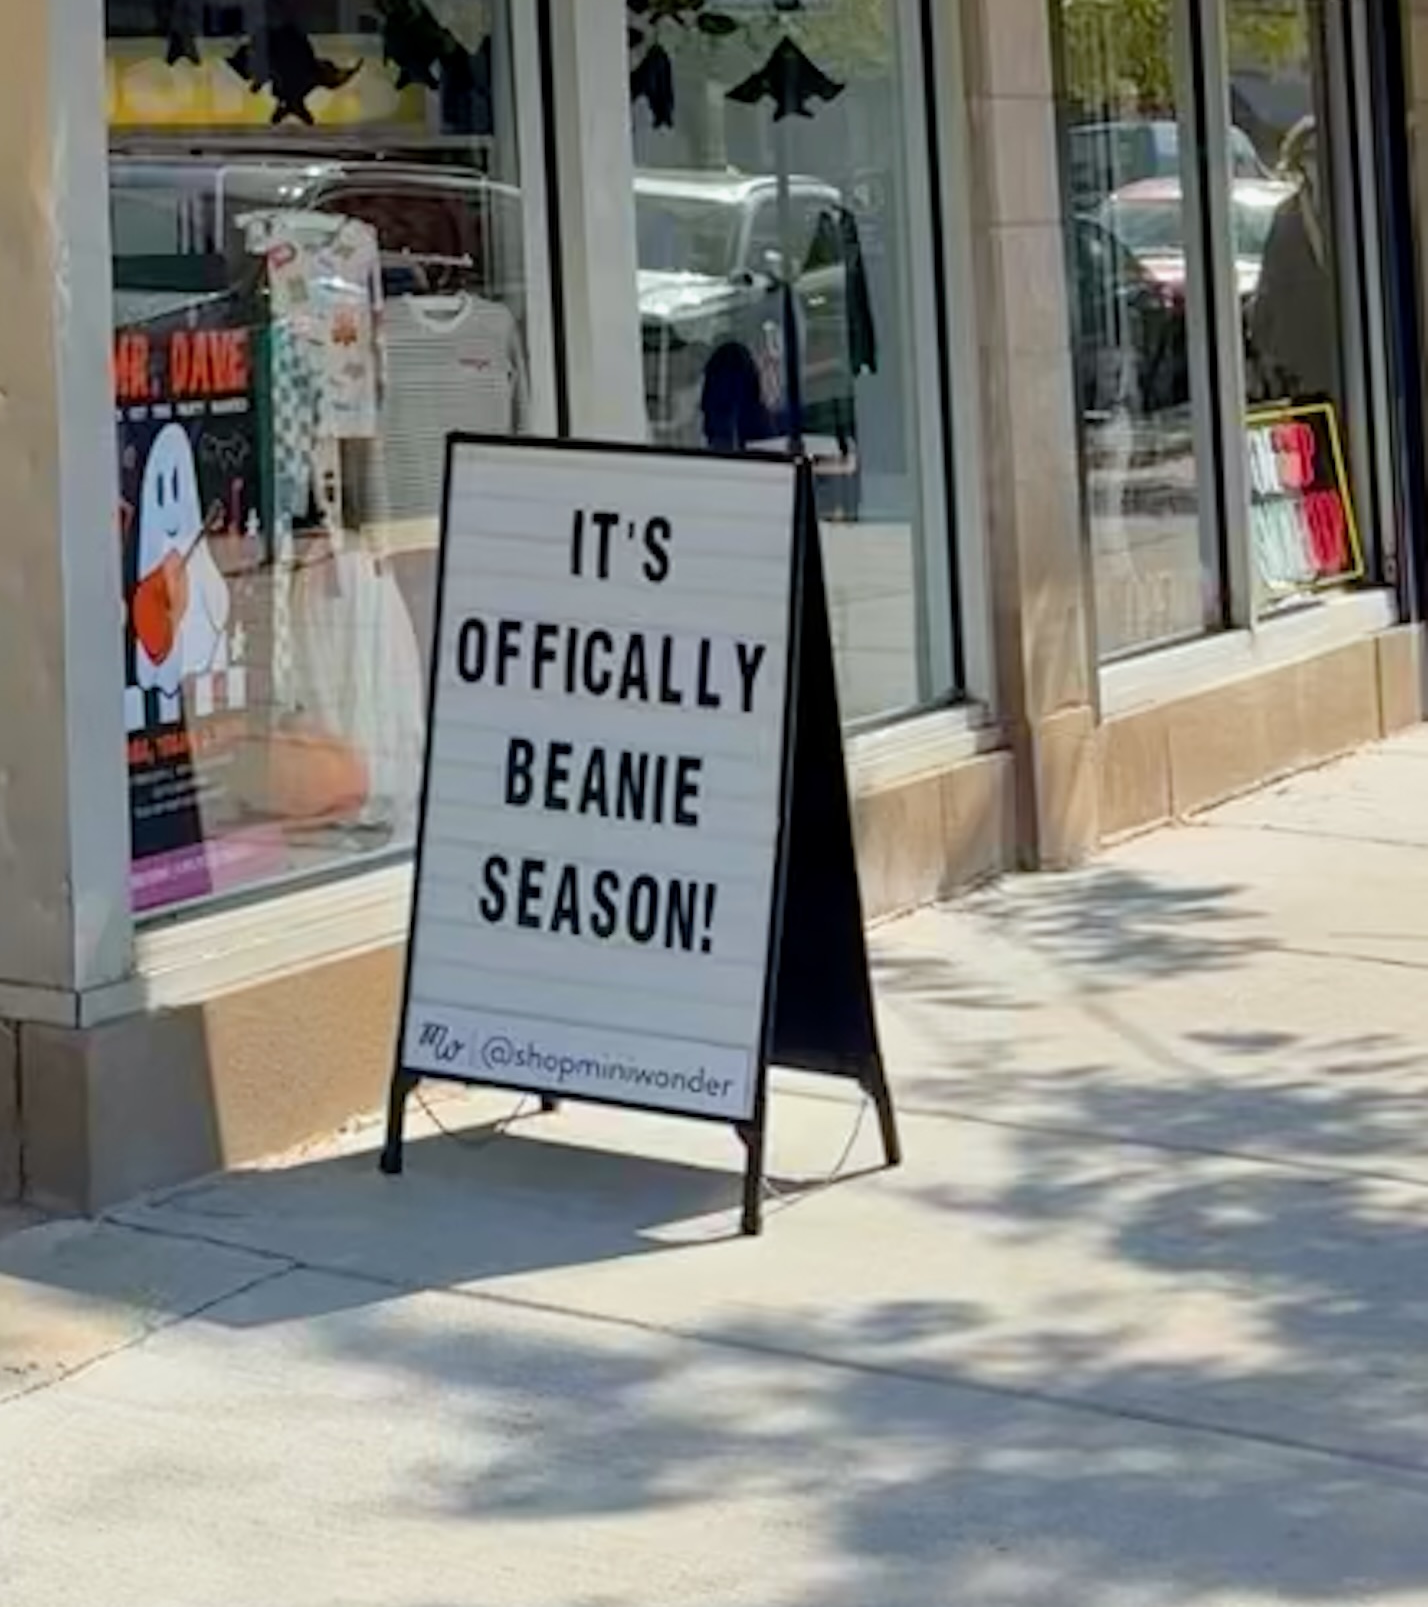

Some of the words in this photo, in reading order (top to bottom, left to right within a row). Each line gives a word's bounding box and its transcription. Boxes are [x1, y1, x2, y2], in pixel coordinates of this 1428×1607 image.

[570, 509, 672, 584] IT'S
[457, 617, 766, 713] OFFICALLY
[505, 737, 703, 827] BEANIE
[478, 855, 718, 954] SEASON!
[482, 1035, 736, 1098] @shopminiwonder
